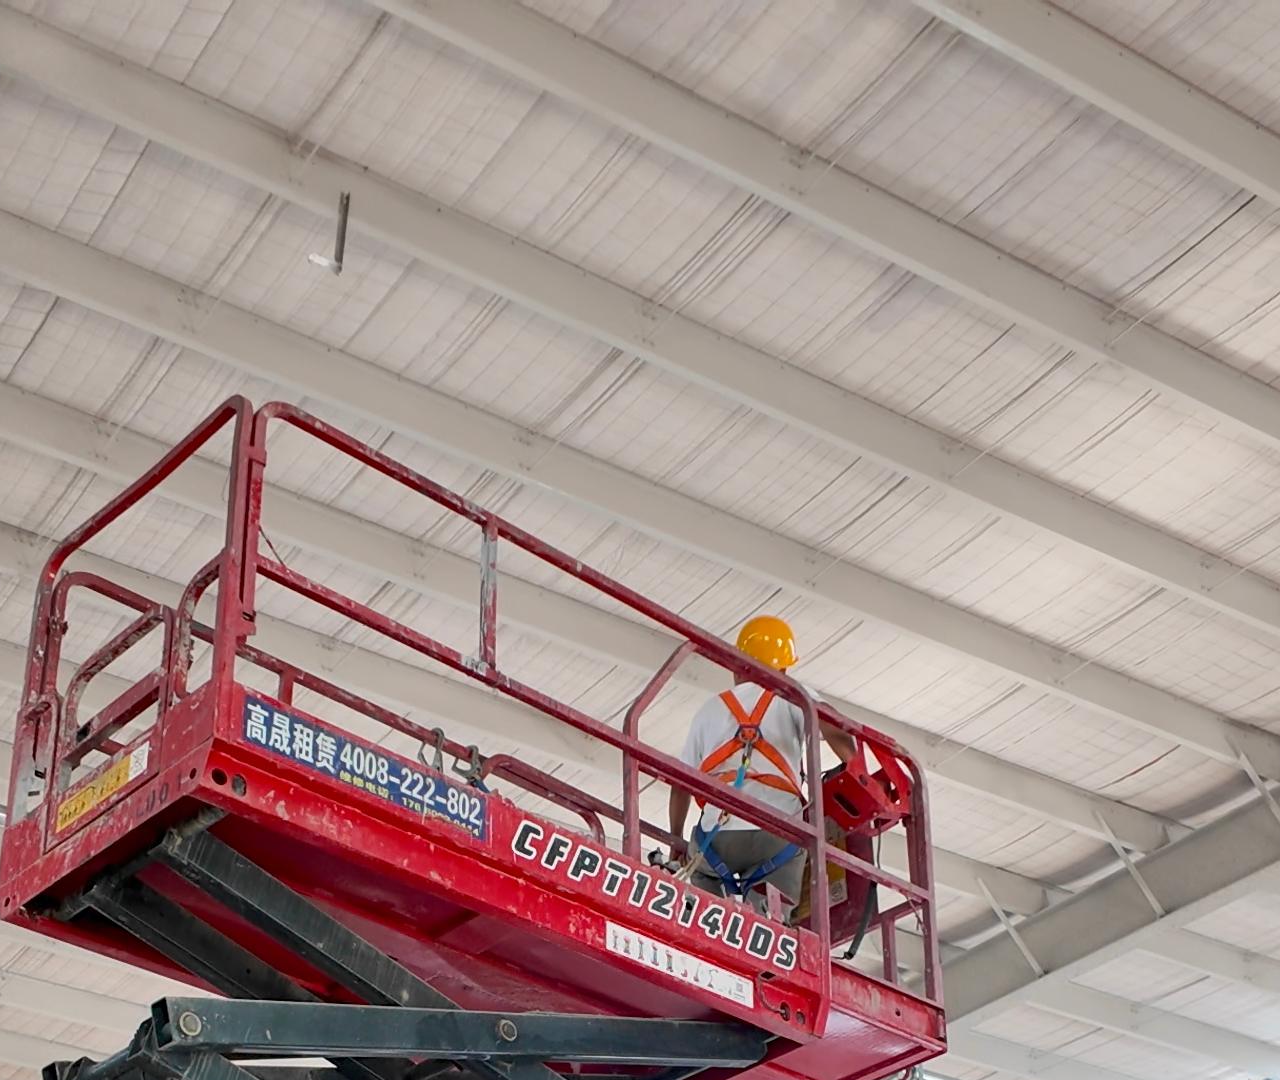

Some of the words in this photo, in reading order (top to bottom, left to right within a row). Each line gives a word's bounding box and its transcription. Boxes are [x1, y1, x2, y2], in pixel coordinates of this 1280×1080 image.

[246, 703, 337, 775] 高晟租赁
[340, 742, 483, 829] 4008-222-802
[512, 819, 798, 970] CFPT1214LDS
